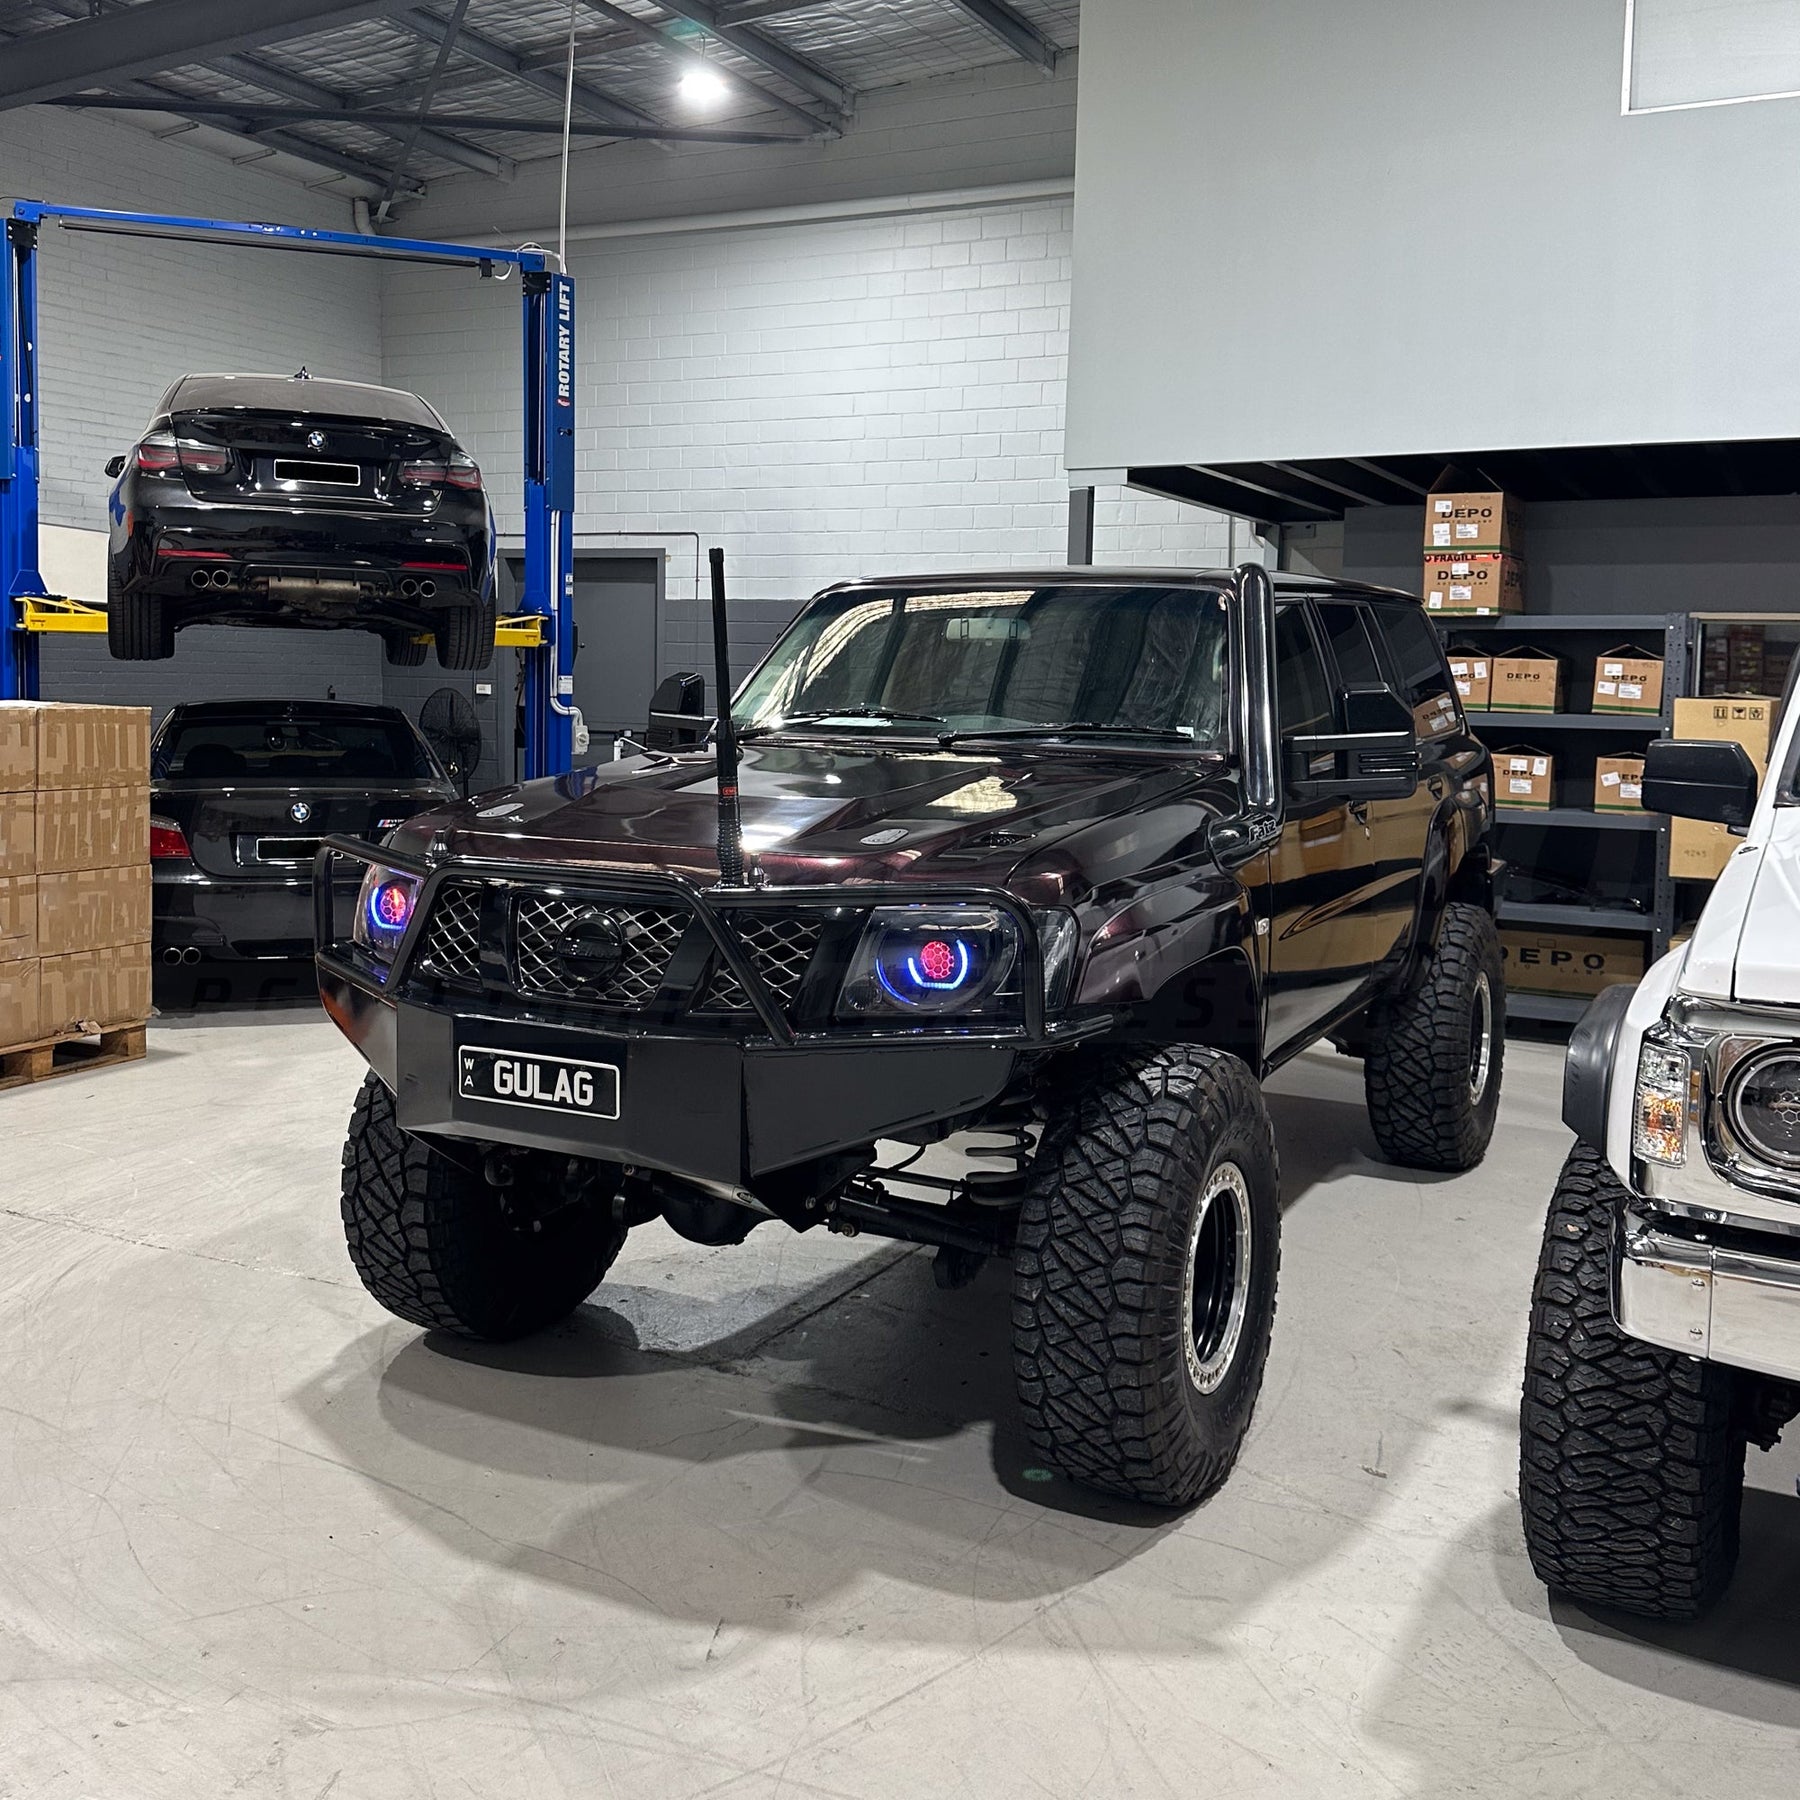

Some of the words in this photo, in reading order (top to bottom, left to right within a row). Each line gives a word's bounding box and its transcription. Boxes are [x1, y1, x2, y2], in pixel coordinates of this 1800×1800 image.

[559, 281, 571, 321] LIFT
[558, 324, 570, 397] ROTARY
[1434, 554, 1477, 562] FRAGILE
[493, 1060, 594, 1107] GULAG
